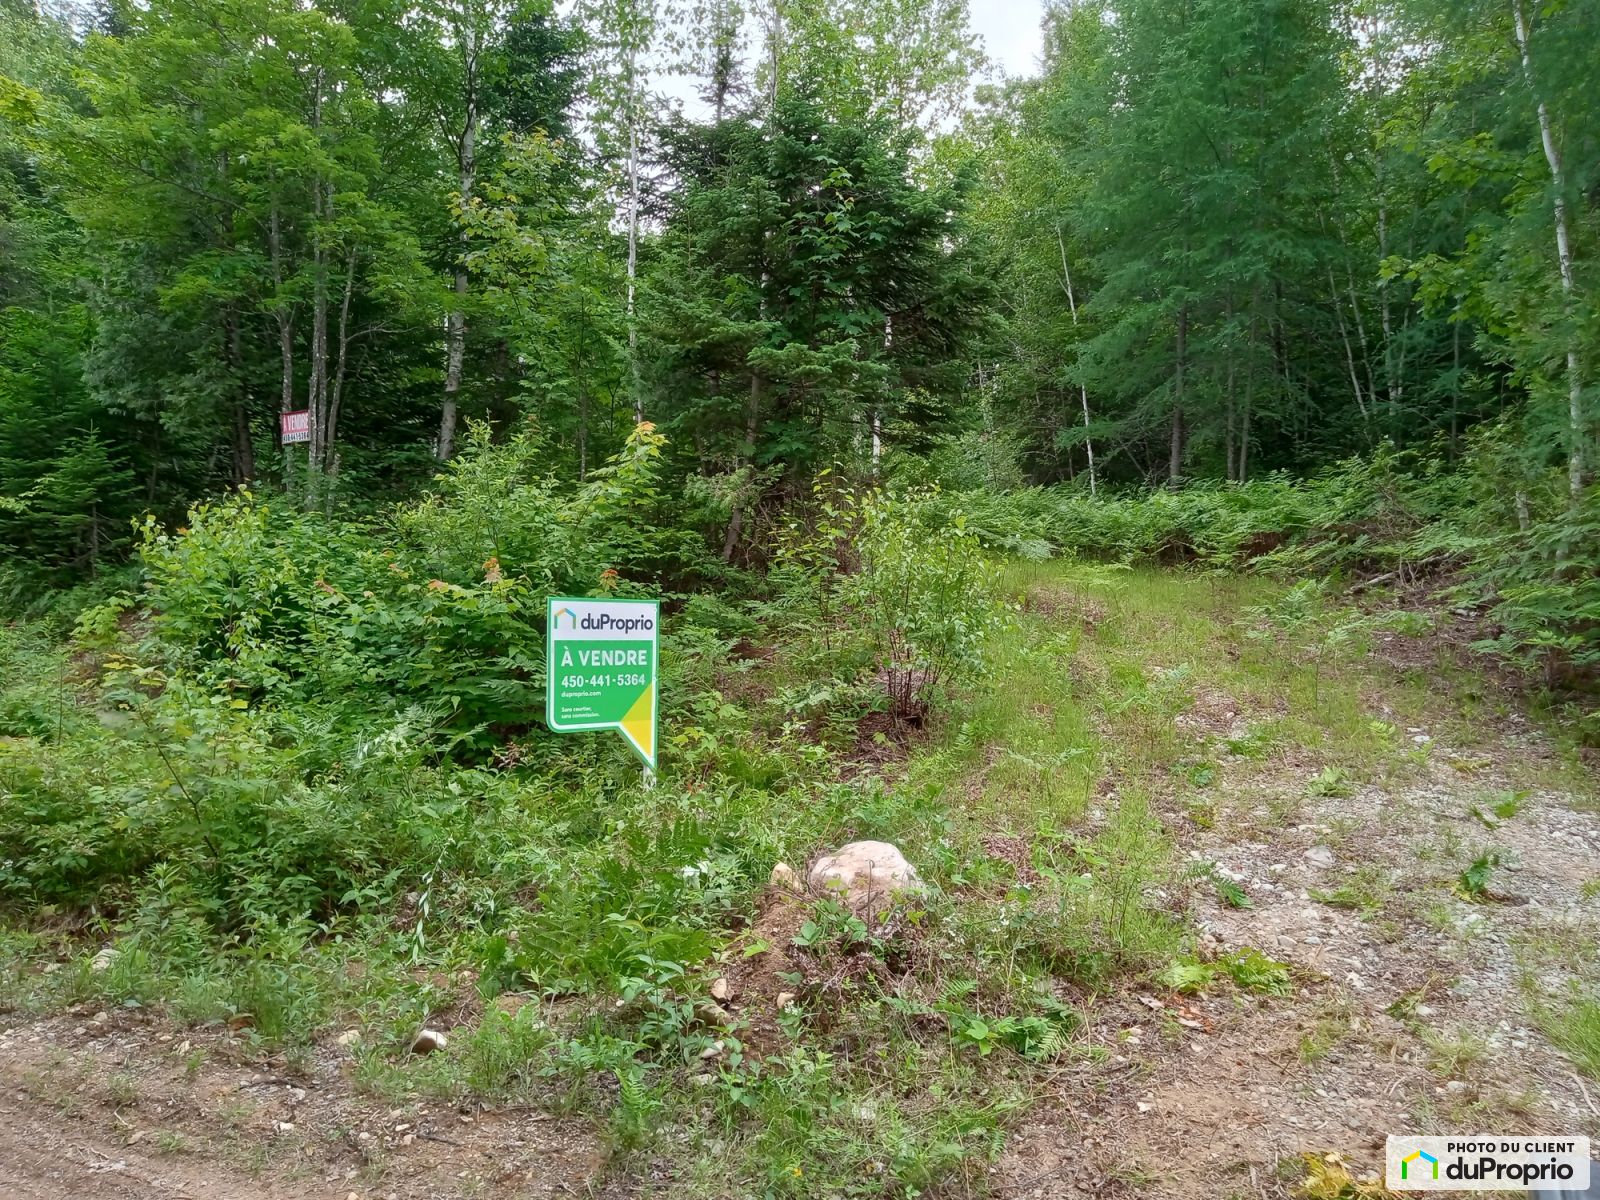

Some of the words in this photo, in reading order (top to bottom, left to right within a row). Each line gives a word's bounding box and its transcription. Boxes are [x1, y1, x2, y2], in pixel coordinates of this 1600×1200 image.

[288, 412, 309, 431] VENDRE
[581, 613, 653, 634] duProprio
[561, 645, 574, 667] À
[578, 649, 648, 667] VENDRE
[561, 673, 646, 688] 450-441-5364
[561, 690, 602, 699] duproprio.com
